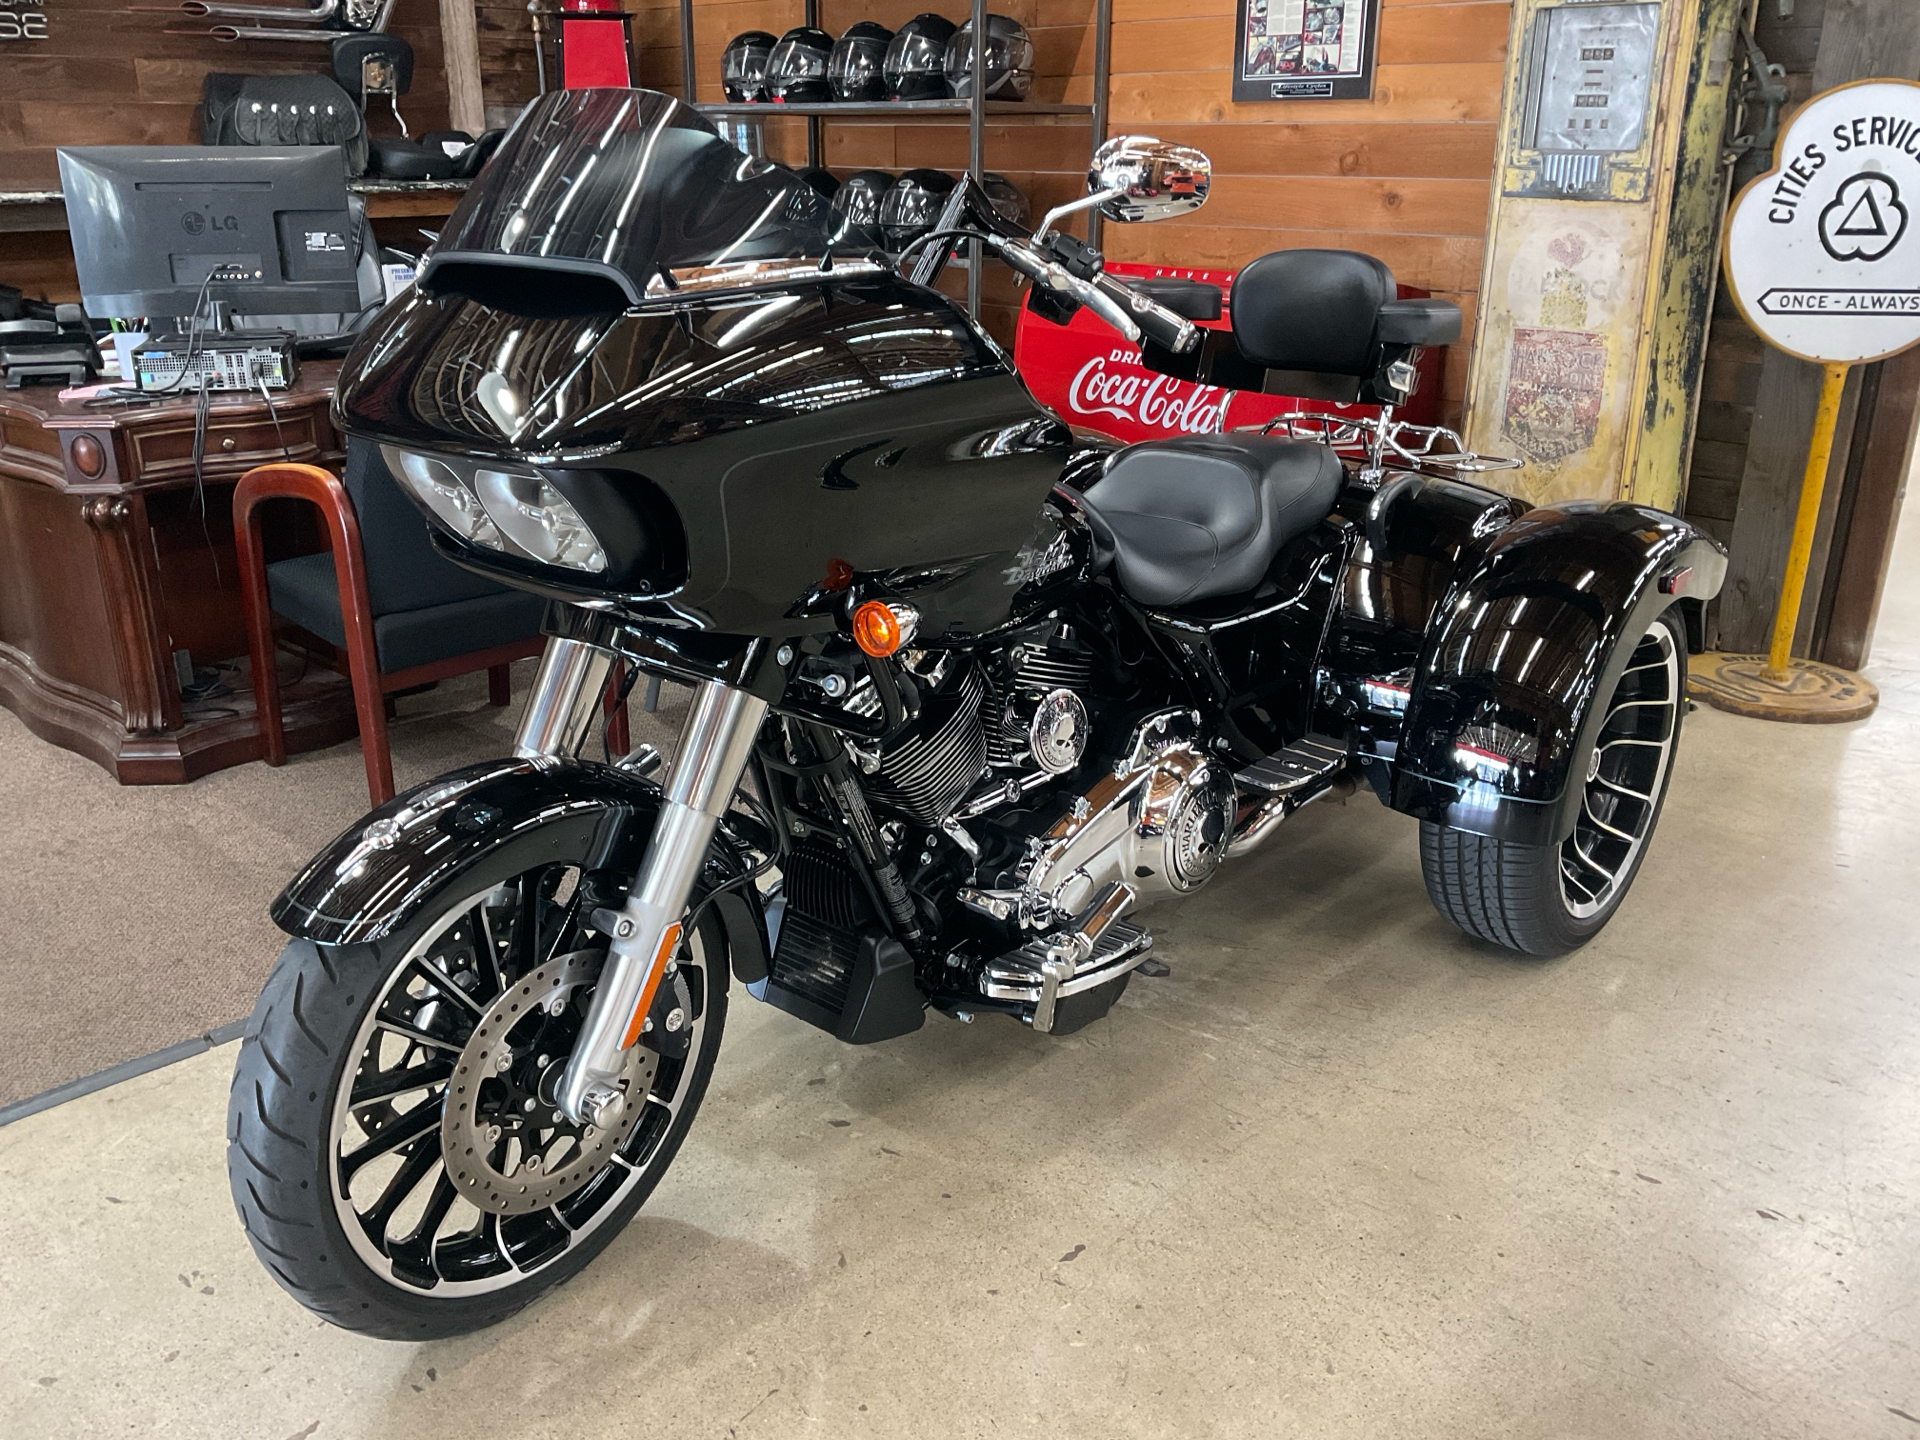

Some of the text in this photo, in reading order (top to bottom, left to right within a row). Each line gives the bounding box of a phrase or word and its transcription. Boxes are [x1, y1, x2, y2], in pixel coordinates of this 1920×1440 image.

[1768, 143, 1827, 224] CITIES
[211, 216, 239, 231] LG
[1155, 268, 1233, 282] HAVE A
[1779, 295, 1829, 309] ONCE
[1845, 296, 1919, 310] ALWAYS
[1109, 349, 1142, 366] DRI
[1069, 357, 1217, 434] Coca-Cola
